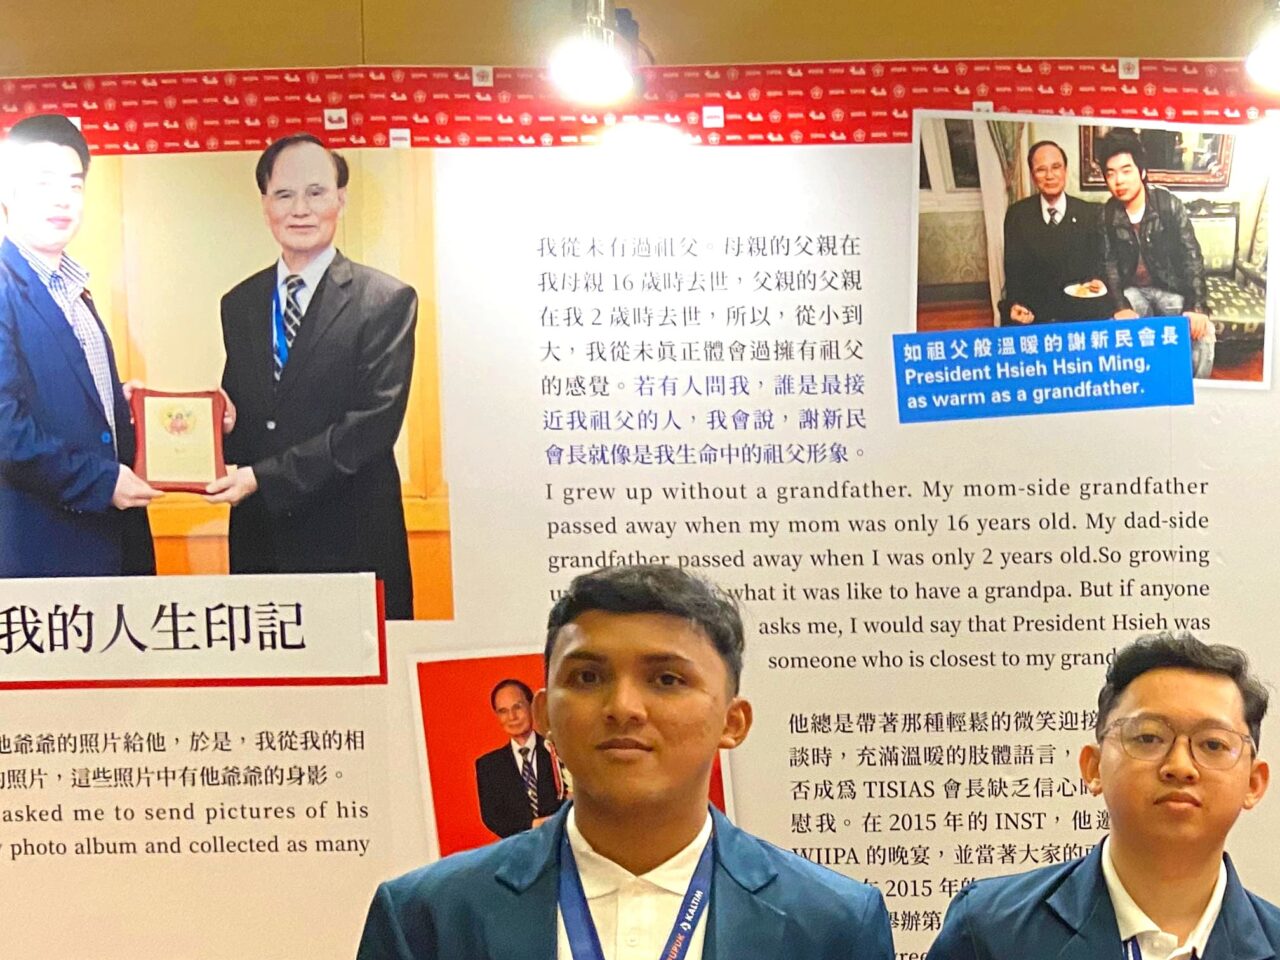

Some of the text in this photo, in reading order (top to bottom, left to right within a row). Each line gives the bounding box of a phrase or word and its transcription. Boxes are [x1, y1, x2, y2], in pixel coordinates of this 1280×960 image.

[904, 326, 1179, 362] 如祖父般溫暖的謝新民會長
[905, 355, 1150, 385] President Hsieh Hsin Ming,
[908, 379, 1144, 408] as warm as a grandfather.
[546, 476, 1208, 505] I grew up without a grandfather. My mom-side grandfather
[0, 602, 306, 654] 我的人生印記
[863, 780, 935, 798] TISIAS
[3, 801, 368, 824] asked me to send pictures of his
[792, 812, 882, 833] 慰我。在
[889, 813, 936, 831] 2015
[944, 811, 987, 832] 年的
[11, 835, 370, 861] photo album and collected as many
[685, 890, 703, 922] KALTIM
